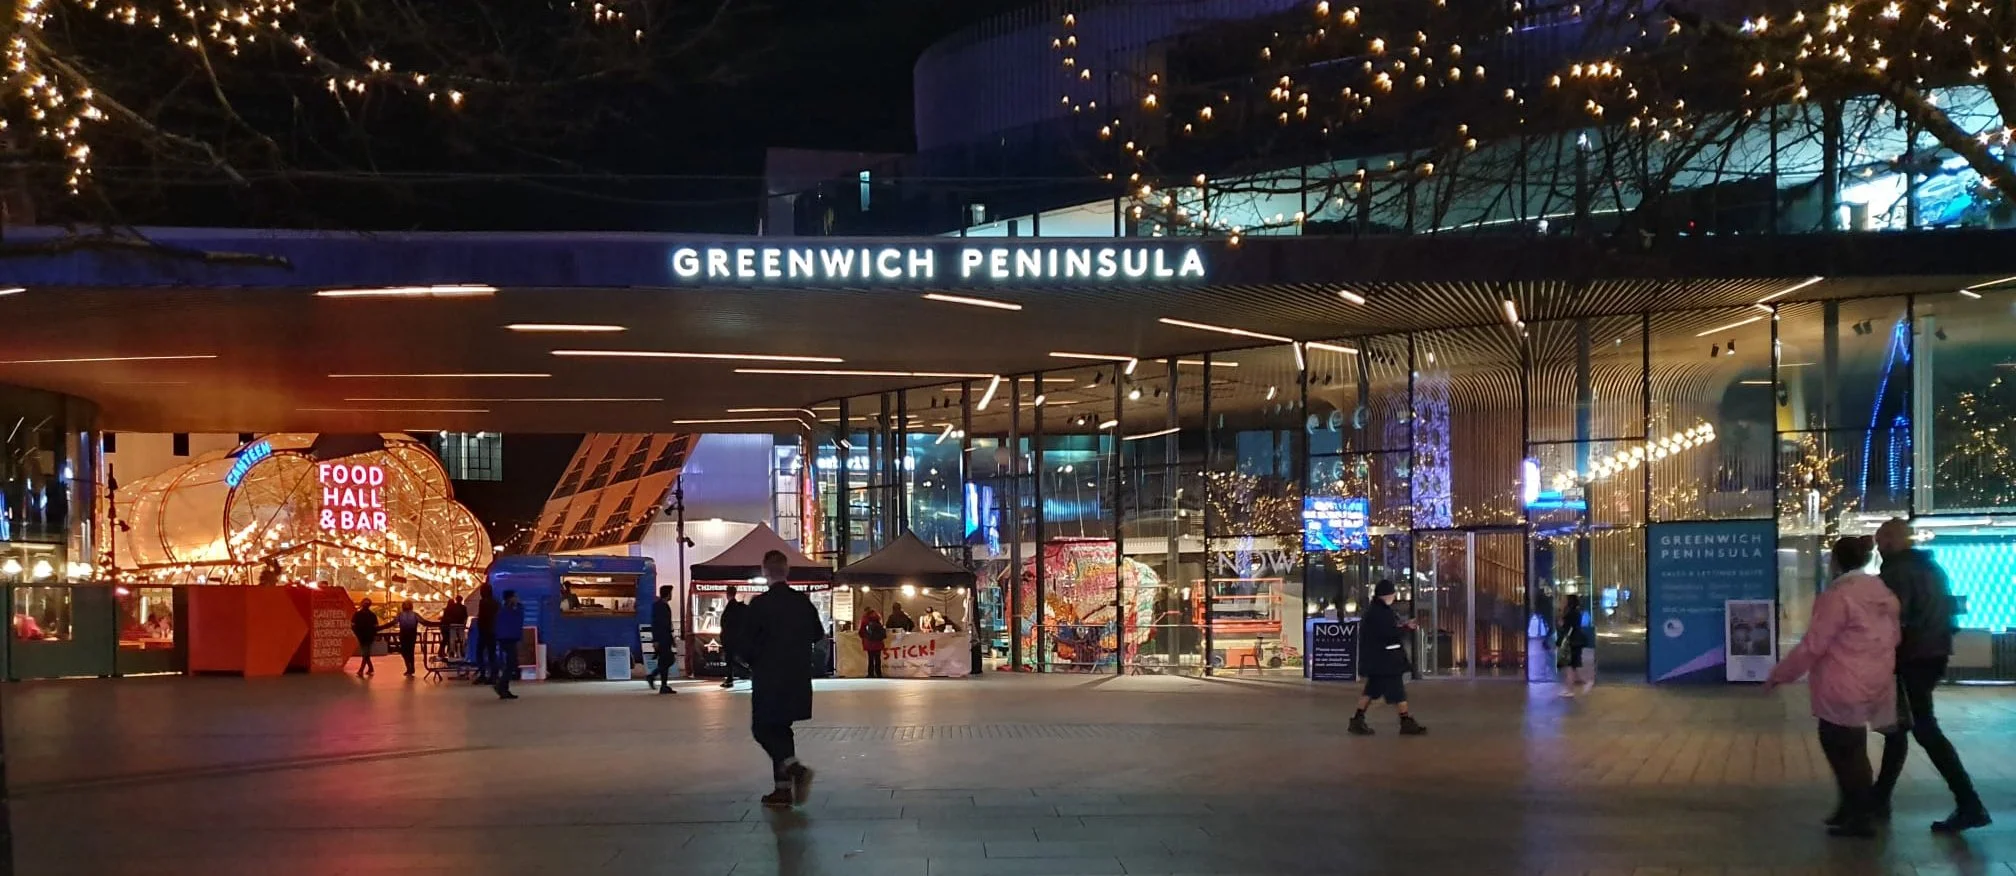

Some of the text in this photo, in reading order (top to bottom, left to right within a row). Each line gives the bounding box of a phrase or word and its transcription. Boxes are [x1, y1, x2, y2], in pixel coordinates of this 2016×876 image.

[672, 247, 1207, 279] GREENWICH PENINSULA
[225, 440, 273, 488] CANTEEN
[318, 463, 385, 487] FOOD
[322, 486, 383, 509] HALL
[318, 509, 388, 531] & BAR
[1661, 534, 1762, 545] GREENWICH
[1661, 548, 1762, 559] PENINSULA
[1315, 624, 1355, 636] NOW
